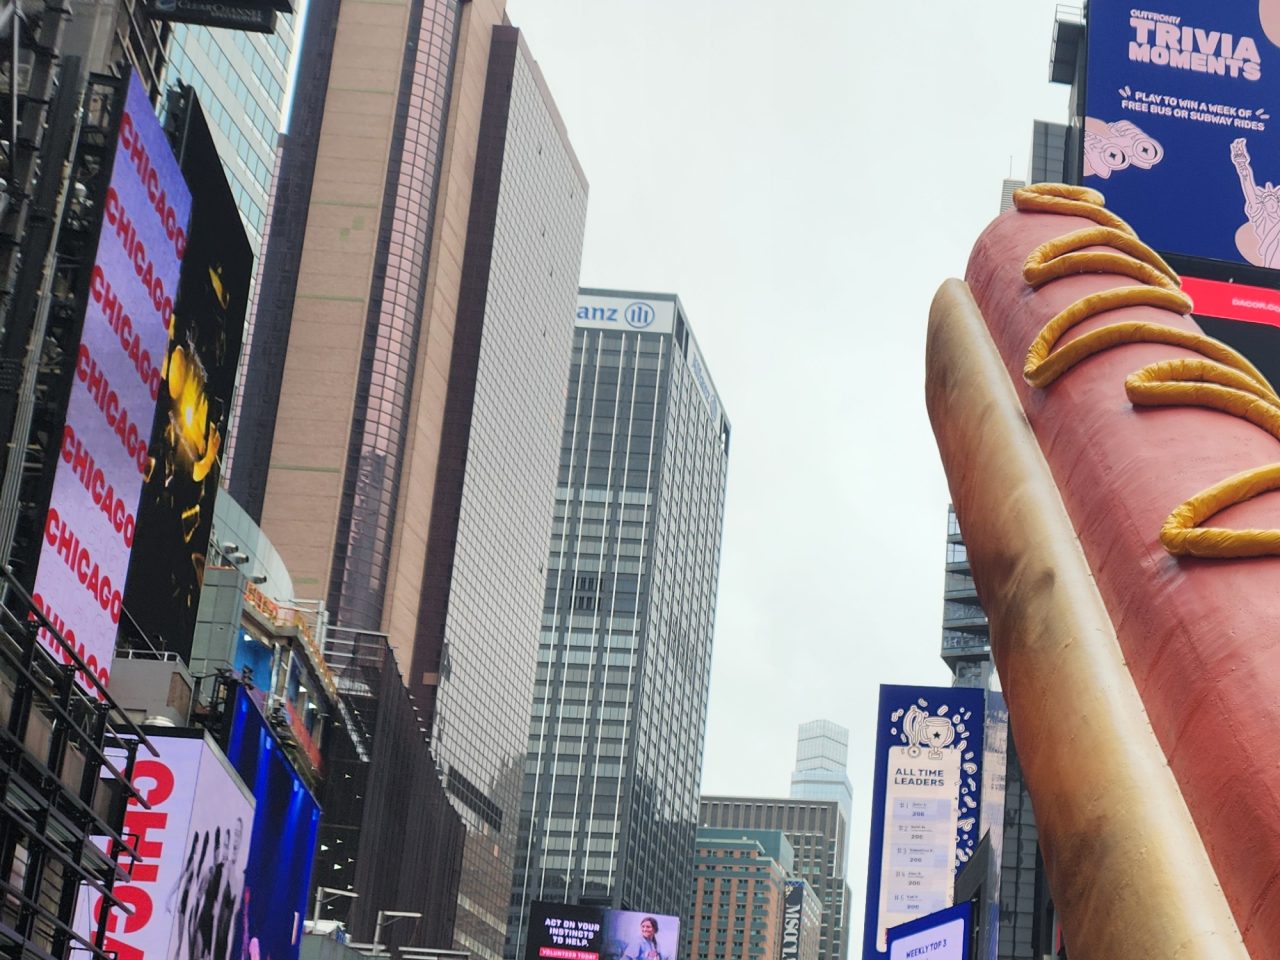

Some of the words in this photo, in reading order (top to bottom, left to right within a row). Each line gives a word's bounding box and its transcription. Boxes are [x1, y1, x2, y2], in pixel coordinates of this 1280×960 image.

[1130, 17, 1261, 64] TRIVIA
[1129, 41, 1261, 81] MOMENTS
[1121, 99, 1149, 112] FREE
[1150, 104, 1172, 116] BUS
[1173, 108, 1189, 119] OR
[1189, 110, 1233, 126] SUBWAY
[1234, 118, 1265, 131] RIDES
[1135, 91, 1165, 104] PLAY
[1165, 96, 1177, 106] TO
[1178, 98, 1199, 110] WIN
[1199, 102, 1208, 111] A
[1208, 103, 1237, 117] WEEK
[1238, 108, 1252, 118] OF
[119, 111, 188, 261] CHICAGO
[104, 187, 173, 330] CHICAGO
[90, 264, 162, 401] CHICAGO
[76, 343, 150, 474] CHICAGO
[59, 425, 136, 549] CHICAGO
[44, 507, 123, 624] CHICAGO
[894, 777, 945, 786] LEADERS
[895, 768, 916, 776] ALL
[918, 769, 944, 777] TIME
[545, 918, 562, 927] ACT
[563, 920, 575, 928] ON
[578, 921, 600, 931] YOUR
[549, 927, 594, 939] INSTINCTS
[553, 936, 563, 944] TO
[543, 949, 577, 959] VOLUNTEER
[578, 952, 597, 960] TODAY
[906, 944, 929, 959] WEEKLY
[930, 940, 942, 951] TOP
[943, 938, 947, 948] 3
